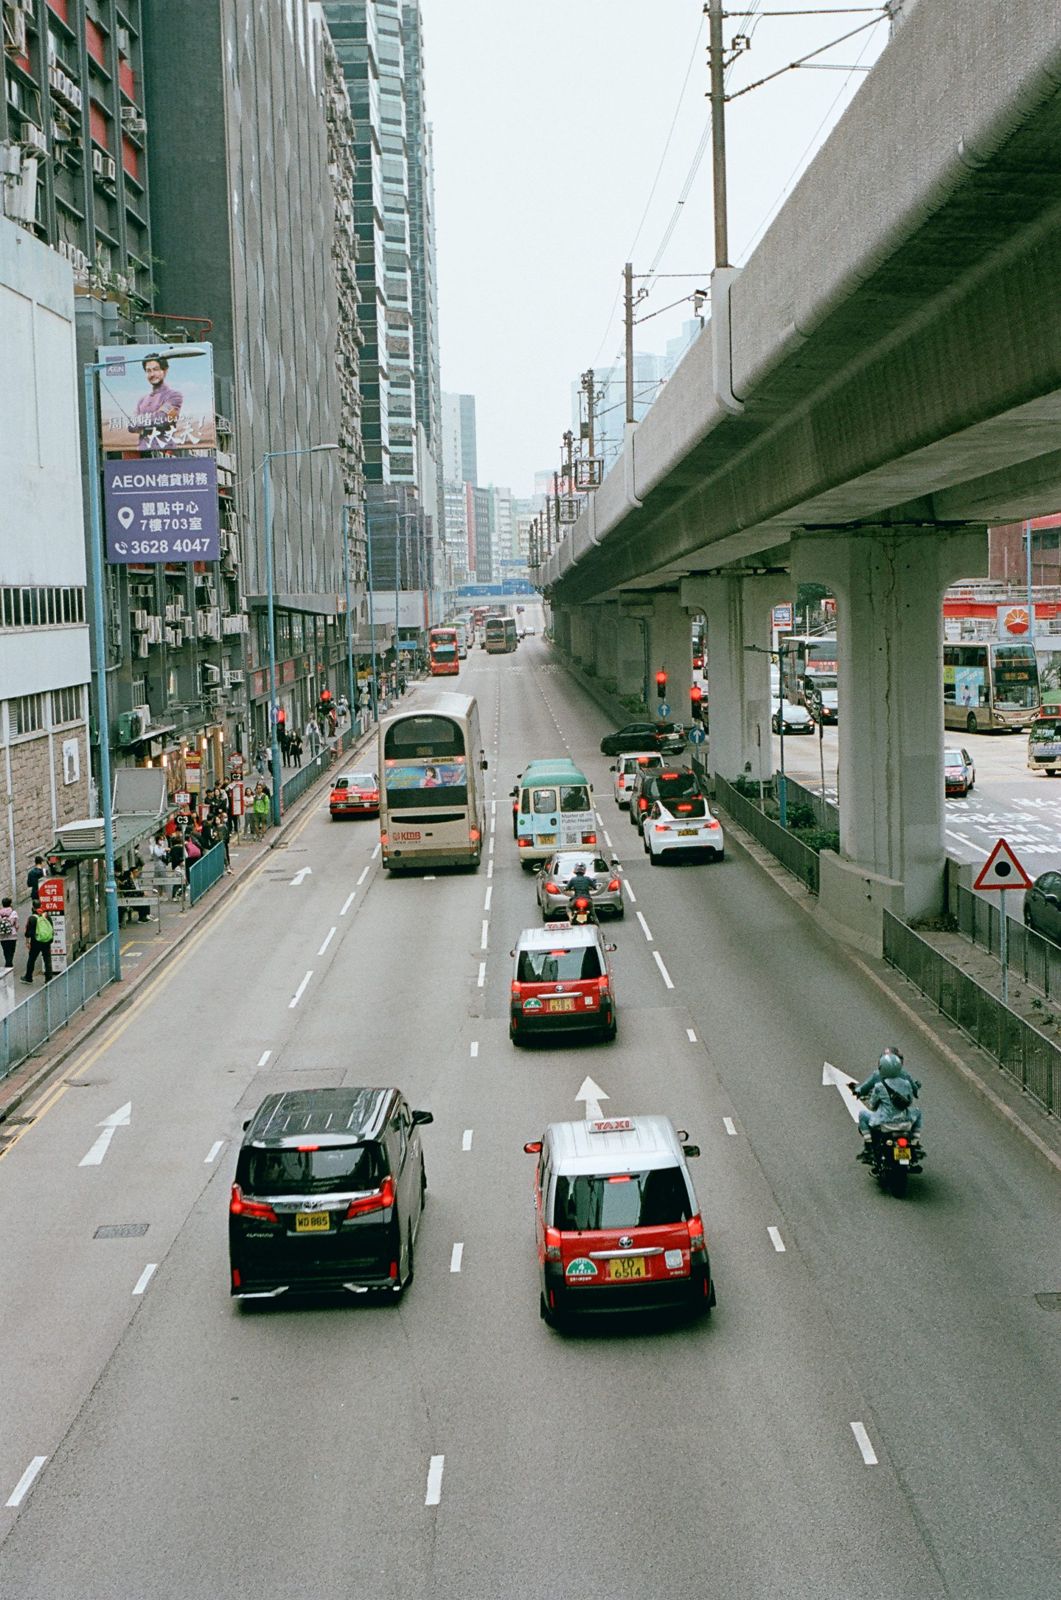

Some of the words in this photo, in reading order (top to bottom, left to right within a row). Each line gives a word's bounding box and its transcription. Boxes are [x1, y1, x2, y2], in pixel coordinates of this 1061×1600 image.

[142, 501, 199, 516] 觀點中心
[140, 517, 202, 532] 7樓703室
[131, 540, 169, 554] 3628
[173, 538, 210, 552] 4047
[177, 815, 189, 824] C3
[595, 1120, 630, 1130] TAXI
[614, 1266, 641, 1278] 6514
